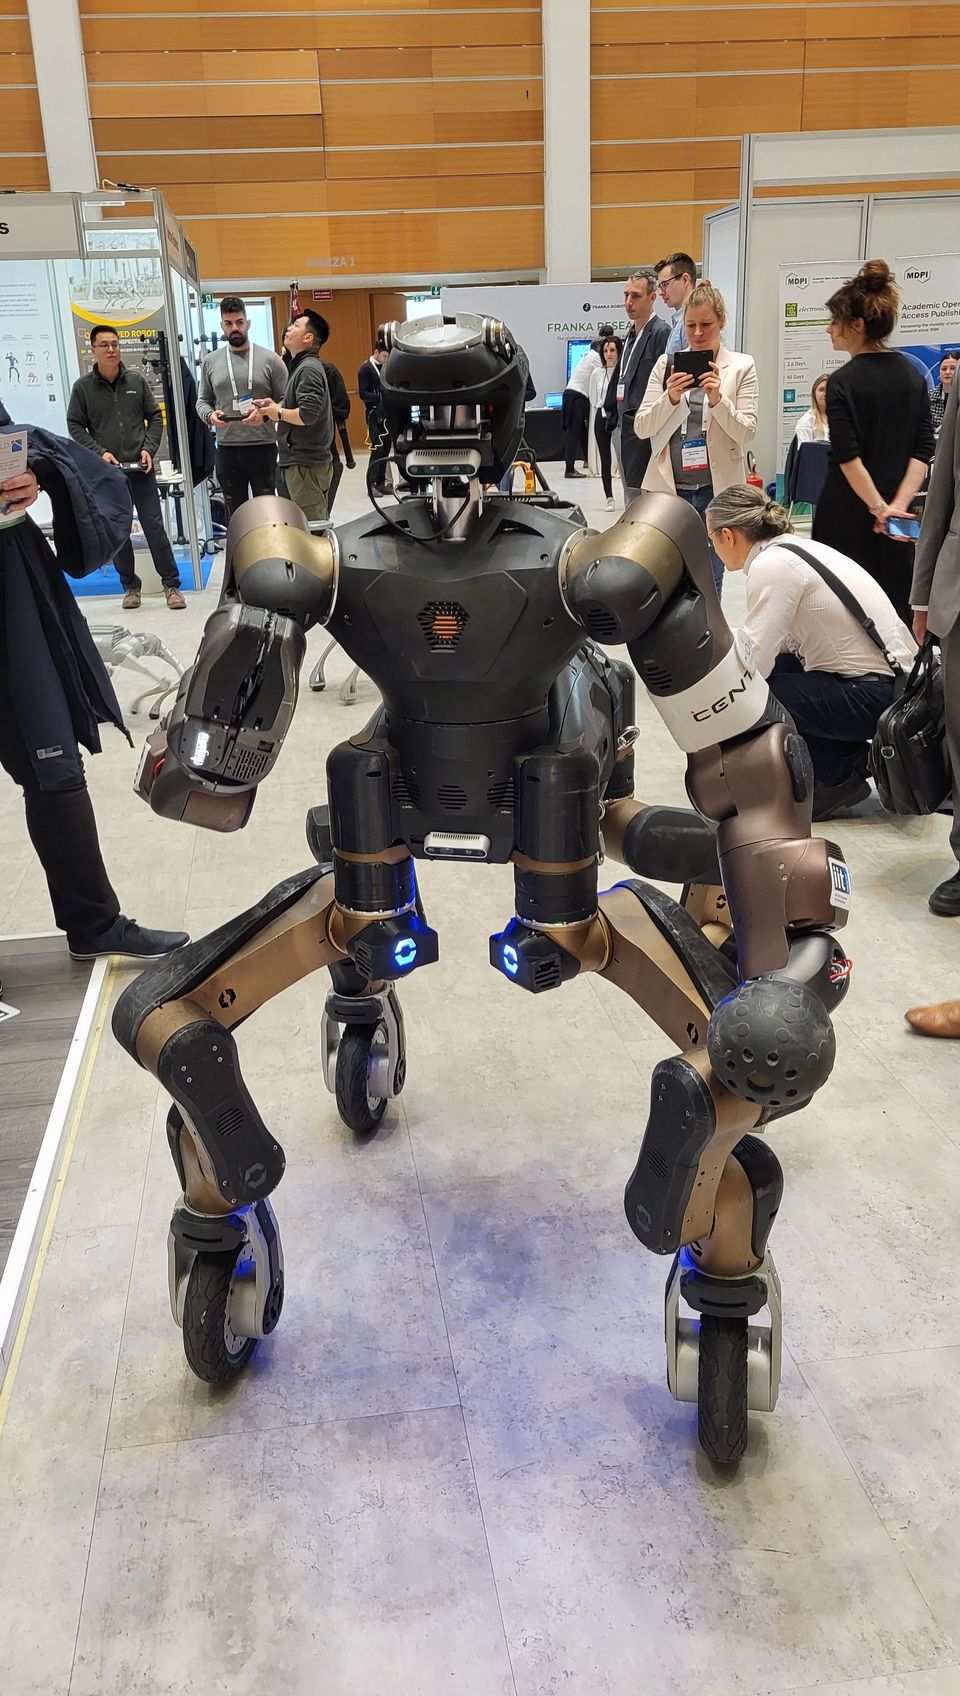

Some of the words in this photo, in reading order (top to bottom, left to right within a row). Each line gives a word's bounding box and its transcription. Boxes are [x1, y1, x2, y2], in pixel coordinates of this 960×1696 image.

[905, 271, 928, 279] MDPI
[788, 277, 808, 285] MDPI
[901, 303, 940, 311] Academic
[901, 312, 929, 320] Access
[547, 322, 594, 332] FRANKA
[832, 865, 846, 891] iit
